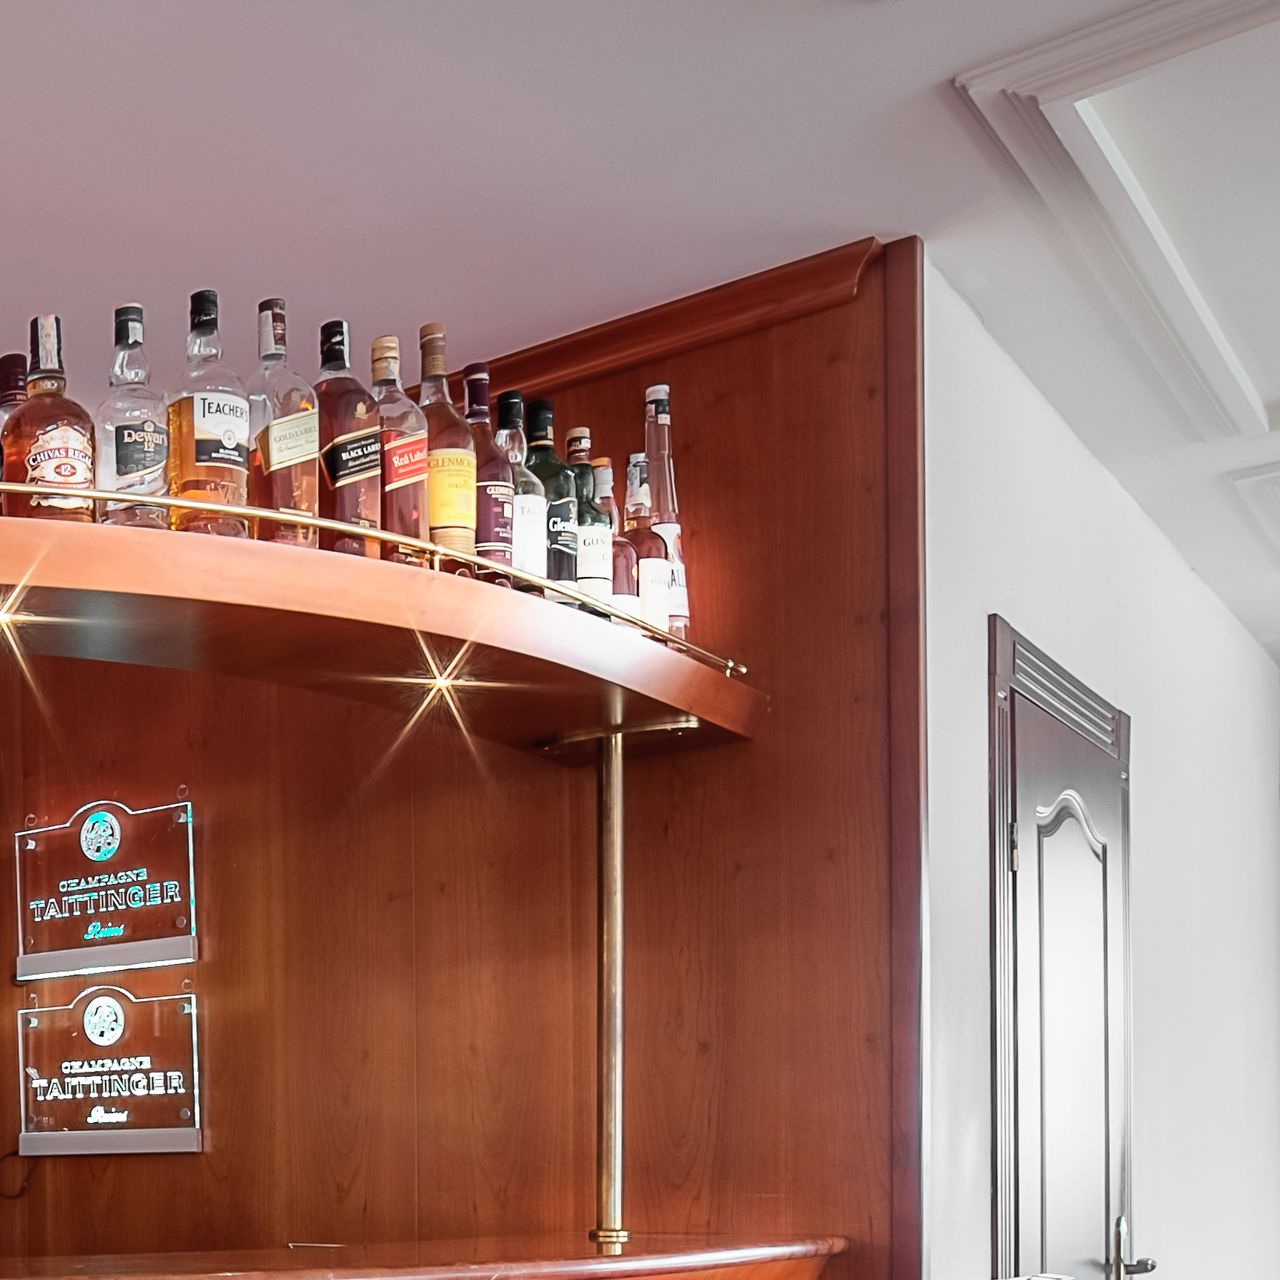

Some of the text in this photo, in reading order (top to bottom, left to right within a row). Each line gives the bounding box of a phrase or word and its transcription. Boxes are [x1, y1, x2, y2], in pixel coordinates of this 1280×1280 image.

[29, 448, 65, 466] CHIVAS
[341, 449, 363, 460] BLACK
[392, 456, 409, 468] Red
[60, 465, 72, 475] 12
[59, 868, 148, 893] CHAMPAGNE
[29, 881, 182, 922] TAITTINGER
[61, 1056, 152, 1074] CHAMPAGNE
[31, 1071, 186, 1101] TAITTINGER
